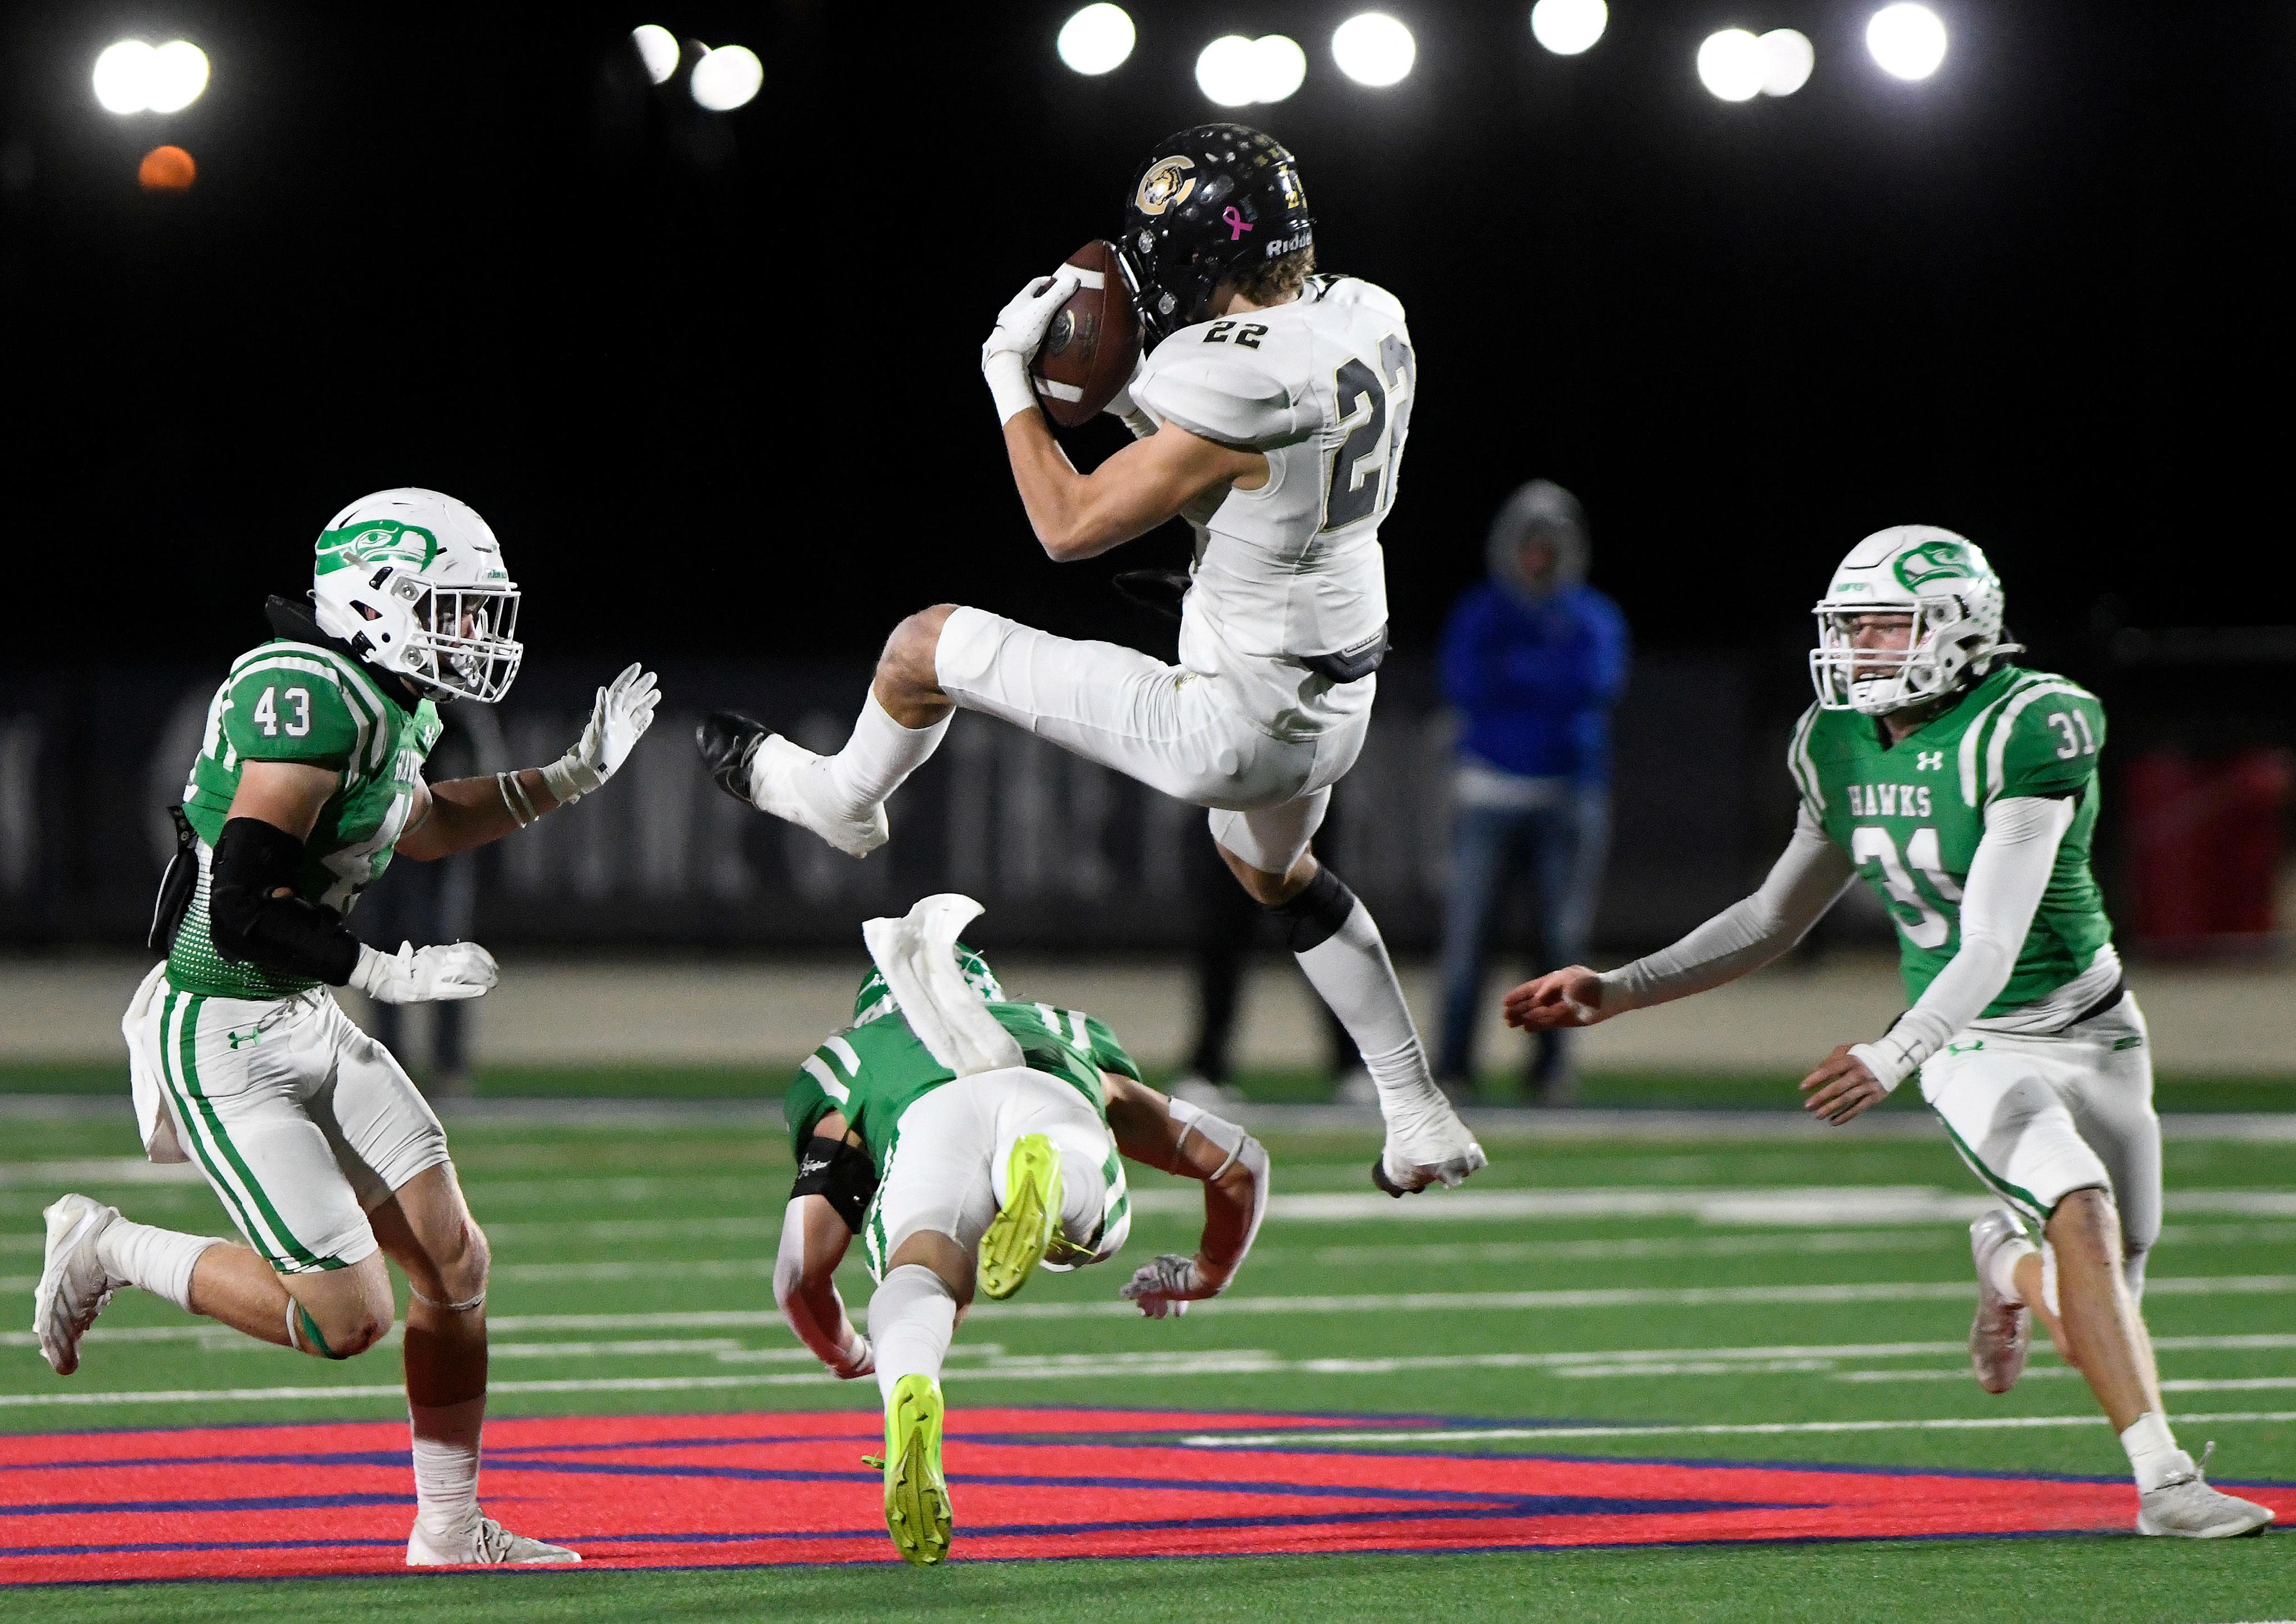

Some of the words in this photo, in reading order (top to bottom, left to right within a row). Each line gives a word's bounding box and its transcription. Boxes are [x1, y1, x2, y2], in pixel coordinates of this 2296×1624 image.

[1203, 320, 1269, 349] 22
[254, 686, 310, 736] 43
[2048, 709, 2096, 759] 31
[1848, 784, 1931, 817] HAWKS
[1851, 827, 1964, 949] 31
